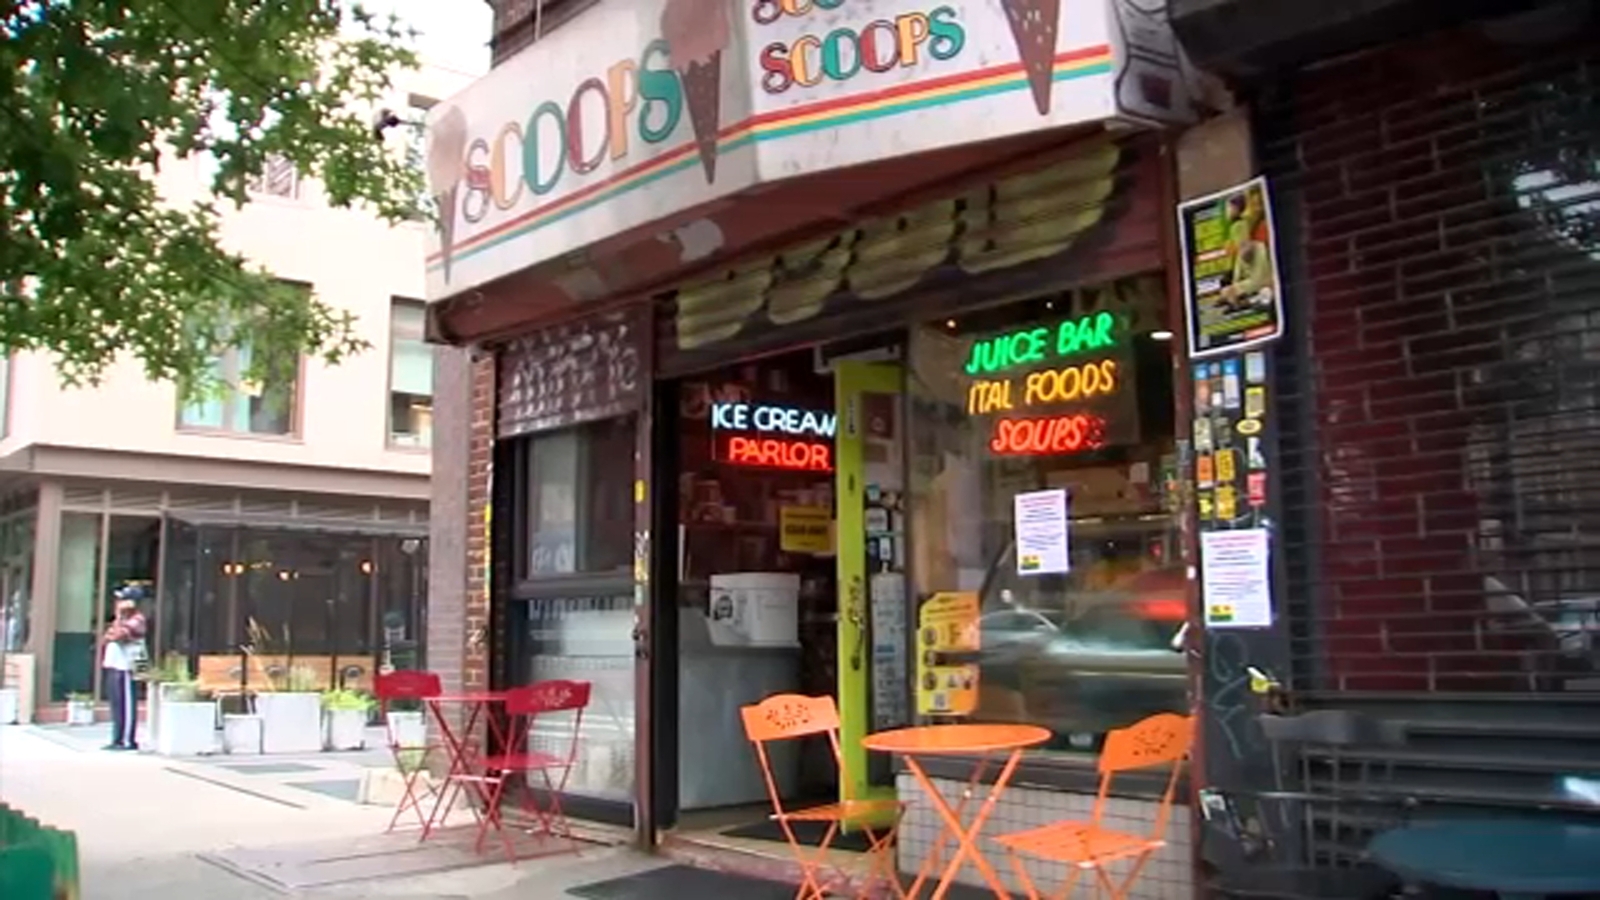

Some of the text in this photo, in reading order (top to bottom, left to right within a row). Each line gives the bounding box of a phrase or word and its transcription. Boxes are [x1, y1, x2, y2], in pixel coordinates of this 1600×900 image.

[762, 6, 965, 94] SCOOPS
[463, 39, 682, 223] SCOOPS
[966, 312, 1114, 373] JUICE BAR
[969, 359, 1116, 415] ITAL FOODS
[712, 403, 748, 429] ICE
[992, 415, 1089, 451] SOUPS
[729, 437, 829, 469] PARLOR
